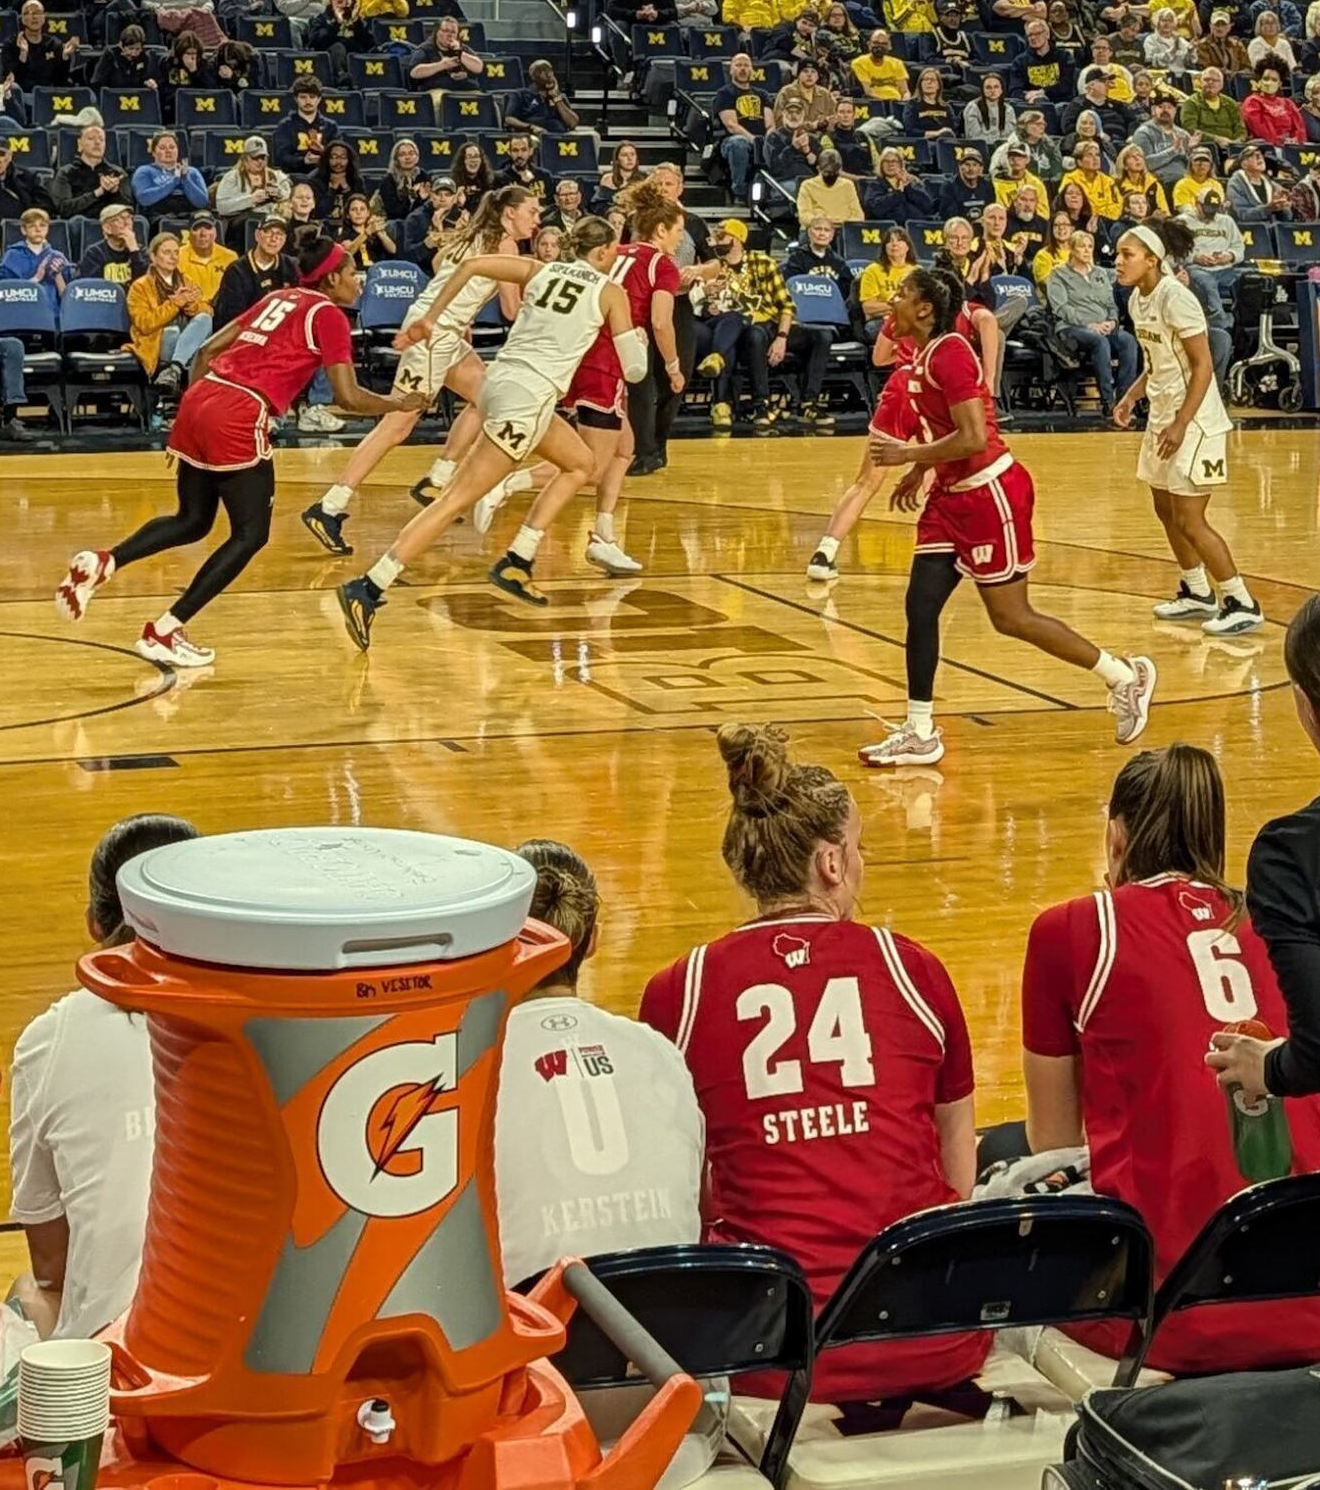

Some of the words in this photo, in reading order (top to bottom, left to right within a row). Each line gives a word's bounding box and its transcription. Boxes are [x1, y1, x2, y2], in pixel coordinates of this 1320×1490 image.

[534, 277, 586, 315] 15
[251, 298, 297, 332] 15
[400, 368, 424, 391] M
[497, 421, 527, 451] M
[1202, 459, 1225, 478] M
[971, 545, 993, 566] W
[1186, 929, 1258, 1023] 6
[736, 976, 876, 1099] 24
[583, 1056, 614, 1077] US
[316, 1033, 459, 1218] G
[763, 1101, 870, 1146] STEELE
